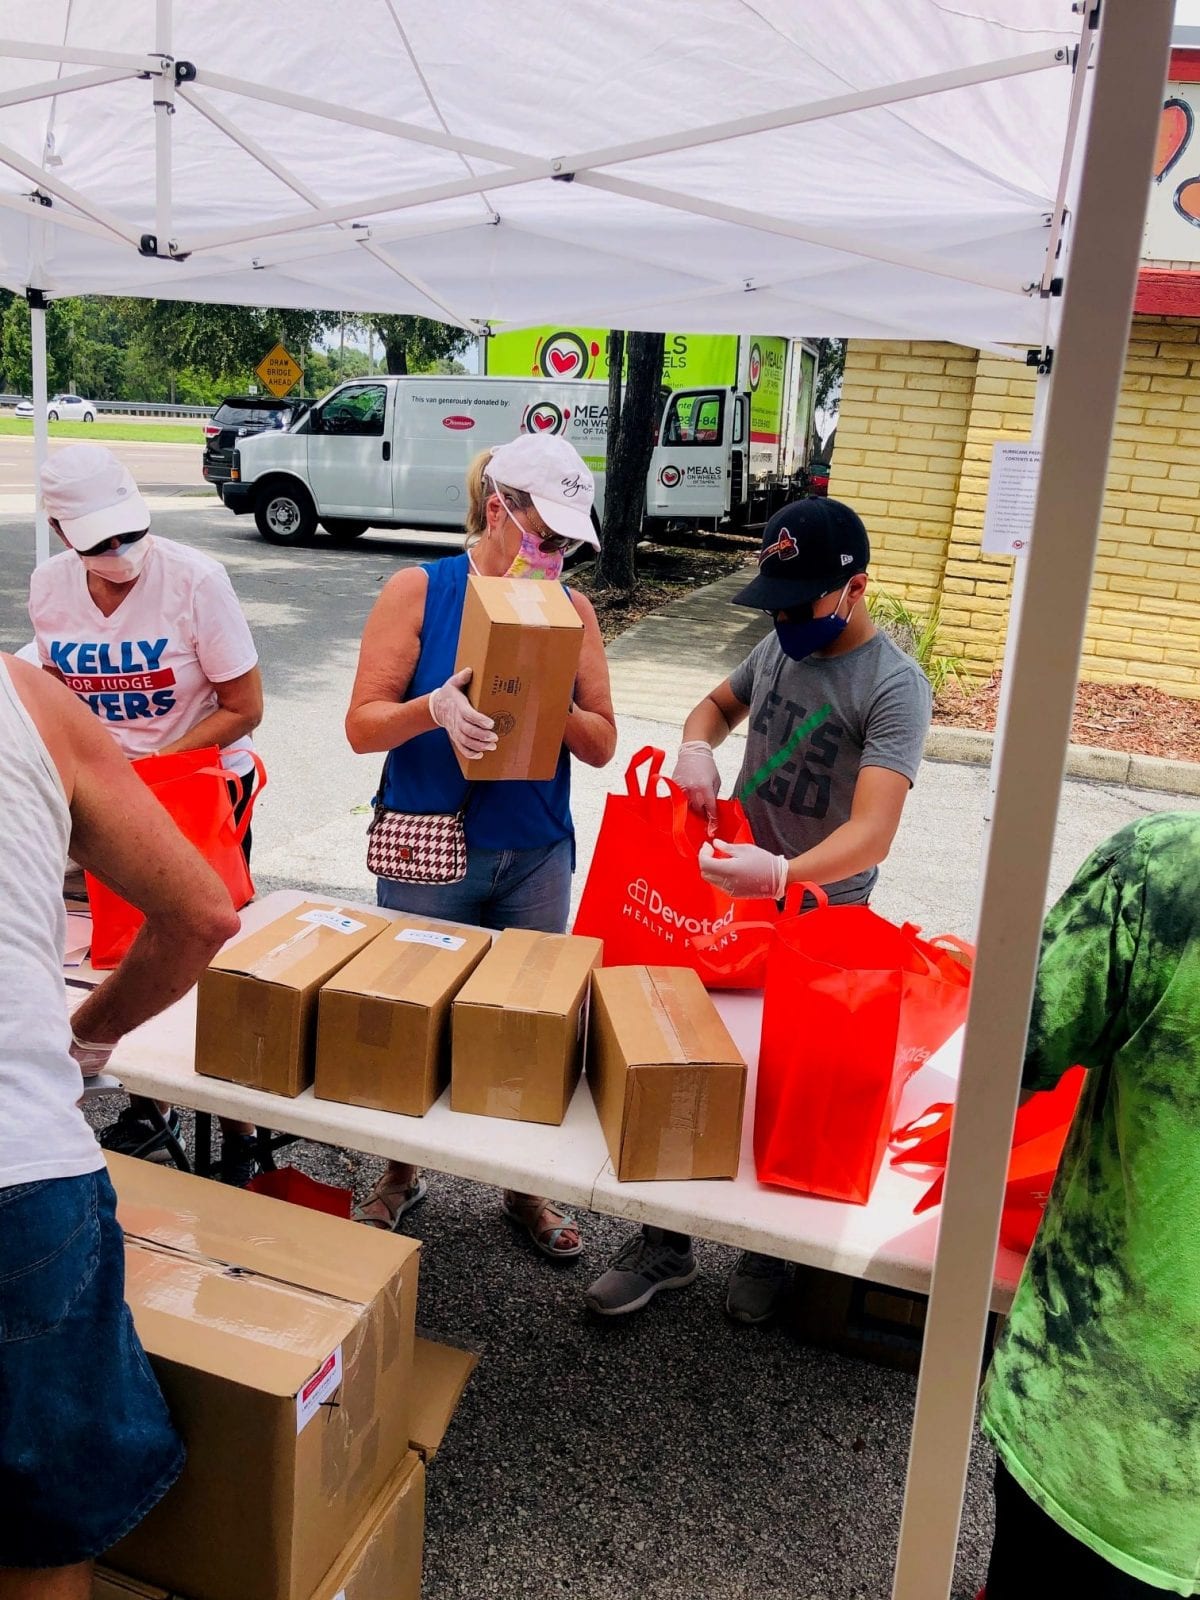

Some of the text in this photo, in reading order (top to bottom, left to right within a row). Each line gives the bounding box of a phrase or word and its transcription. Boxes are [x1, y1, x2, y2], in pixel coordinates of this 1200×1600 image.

[266, 368, 292, 376] BRIDGE
[268, 378, 292, 386] AHEAD
[412, 395, 424, 403] This
[438, 397, 472, 406] generously
[473, 398, 499, 406] donated
[574, 404, 609, 419] MEA
[573, 418, 589, 427] ON
[582, 427, 593, 435] OF
[686, 466, 722, 475] MEALS
[50, 638, 169, 674] KELLY
[100, 675, 154, 691] JUDGE
[648, 889, 735, 935] Devoted
[622, 903, 674, 943] HEALTH
[684, 930, 738, 952] PANS
